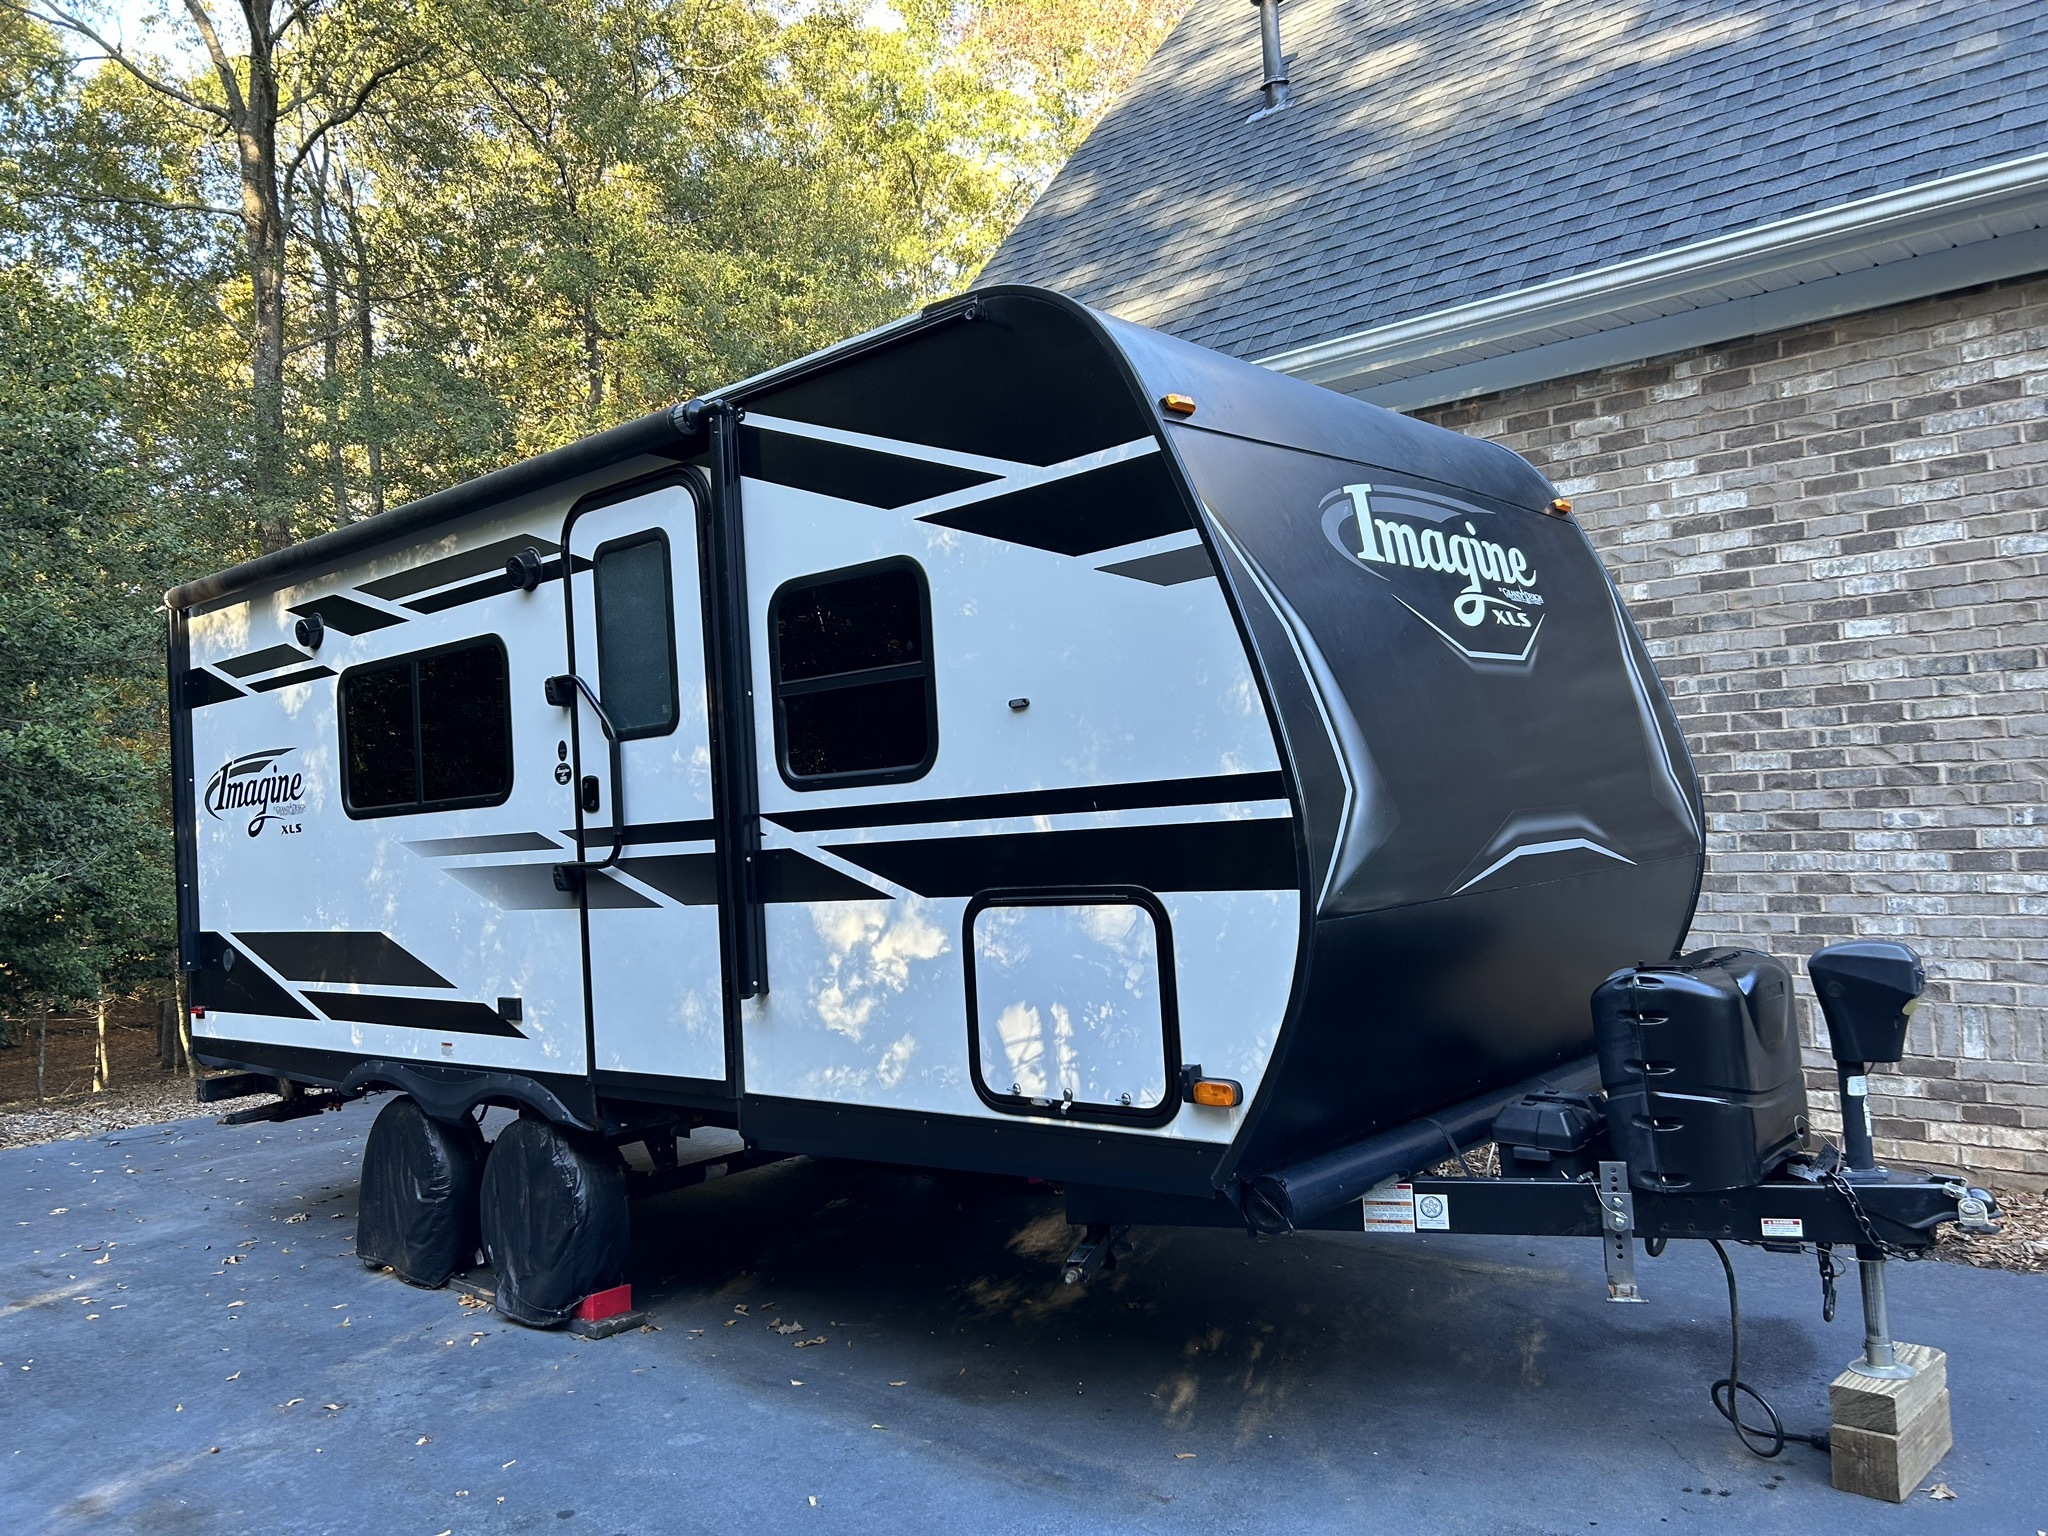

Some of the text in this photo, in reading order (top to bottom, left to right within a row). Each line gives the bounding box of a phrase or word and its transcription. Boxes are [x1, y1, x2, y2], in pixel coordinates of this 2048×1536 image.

[1342, 483, 1537, 627] Imagine
[1491, 609, 1532, 628] XLS
[214, 761, 306, 838] Imagine
[281, 823, 302, 835] XLS
